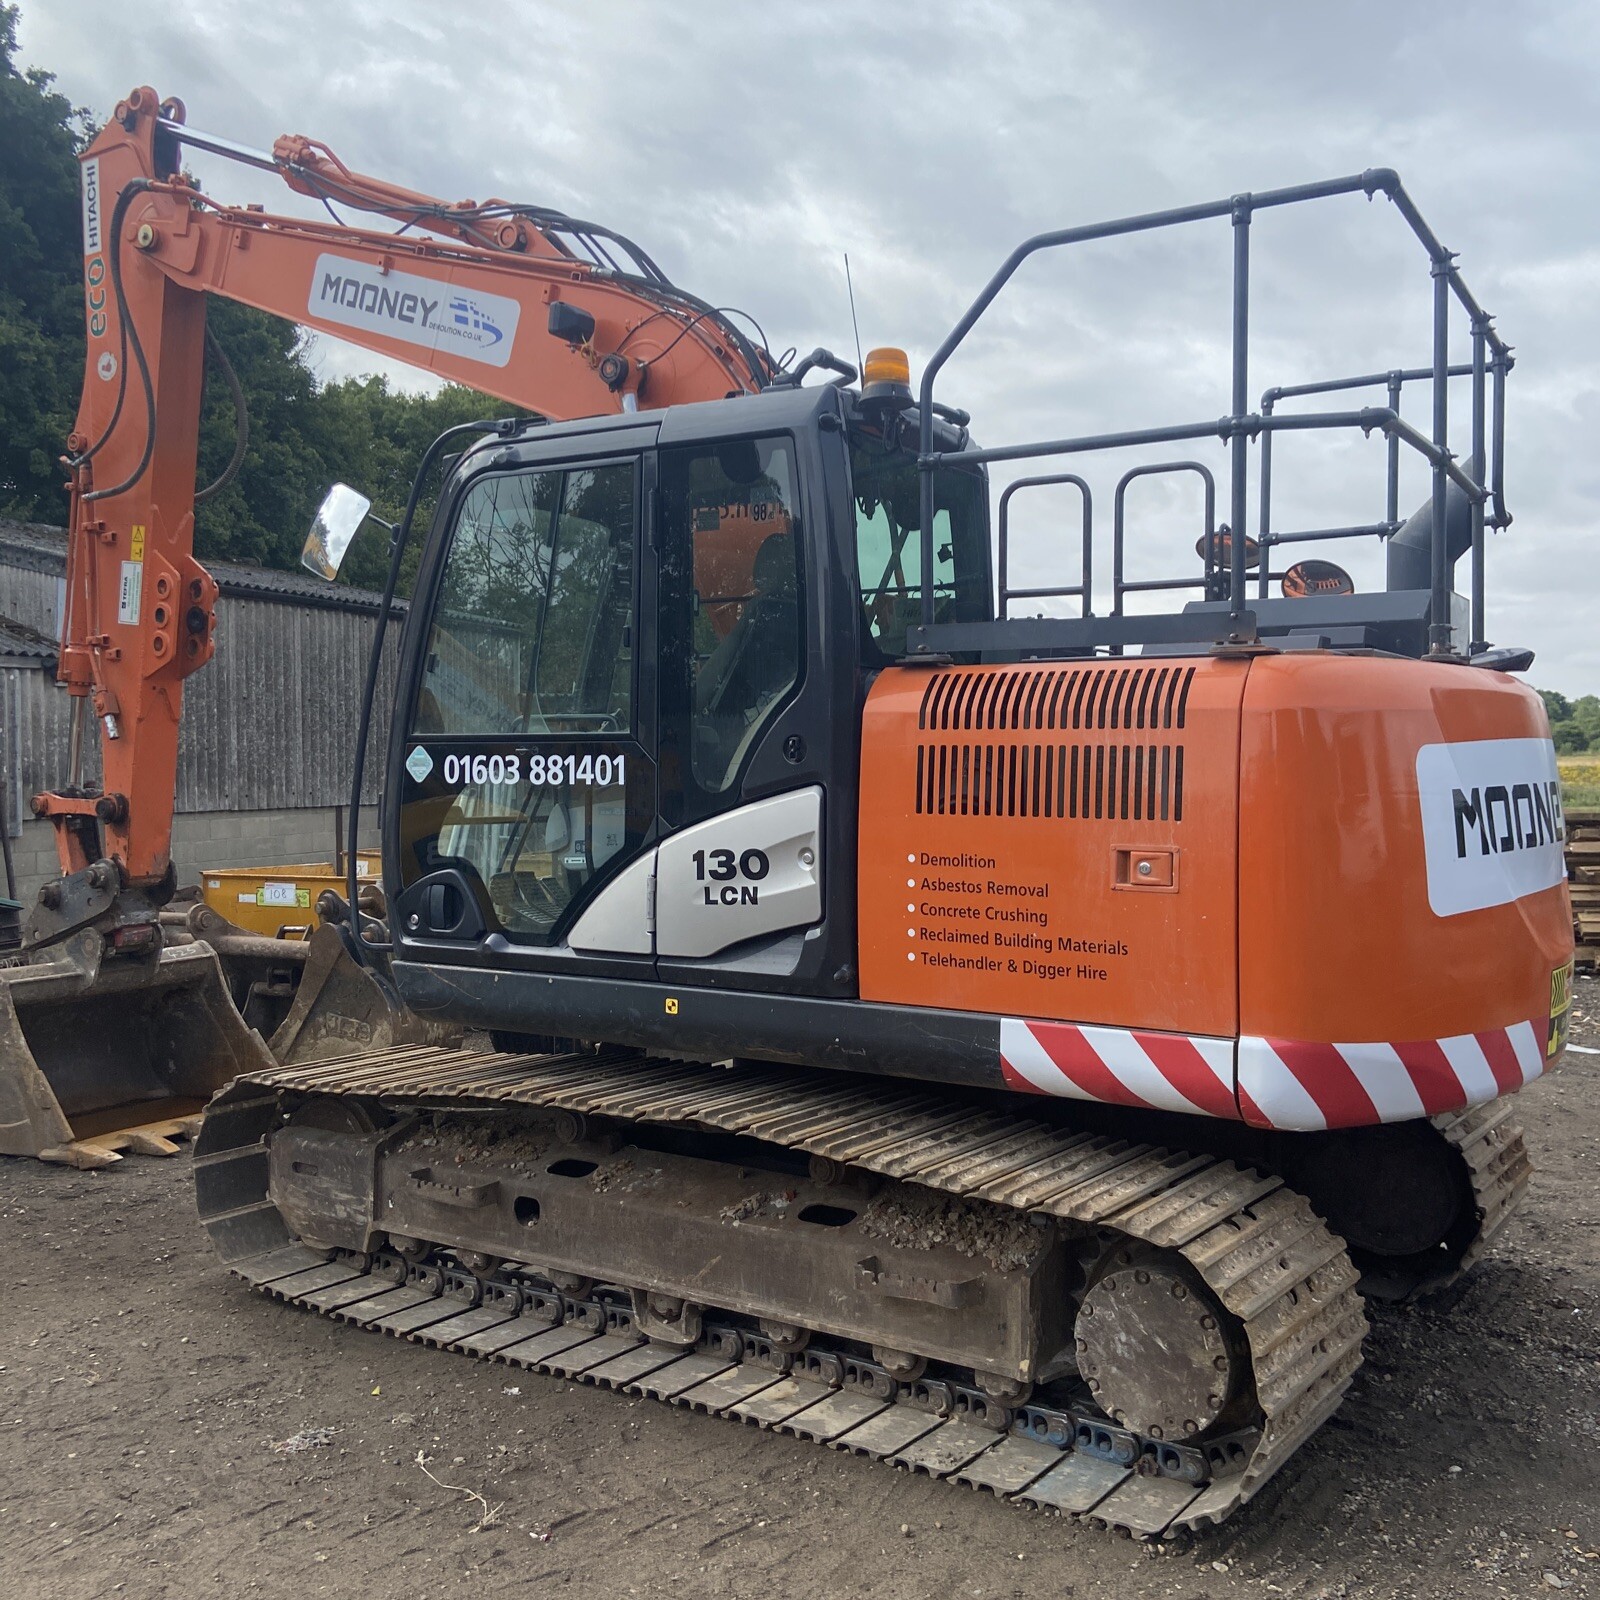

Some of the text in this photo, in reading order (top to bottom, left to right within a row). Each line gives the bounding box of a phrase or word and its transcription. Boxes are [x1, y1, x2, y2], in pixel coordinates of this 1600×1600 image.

[87, 165, 98, 249] HITACHI
[88, 256, 106, 338] eco
[428, 321, 483, 343] DEMOLITION.CO.UK
[753, 503, 767, 522] 98
[443, 754, 520, 785] 01603
[529, 754, 625, 786] 881401
[692, 848, 770, 881] 130
[920, 852, 996, 869] Demolition
[269, 888, 287, 900] 108
[704, 885, 759, 906] LCN
[920, 877, 1049, 898] Asbestos Removal
[920, 902, 1048, 927] Concrete Crushing
[920, 927, 1129, 956] Reclaimed Building Materials
[920, 952, 1108, 981] Telehandler & Digger Hire
